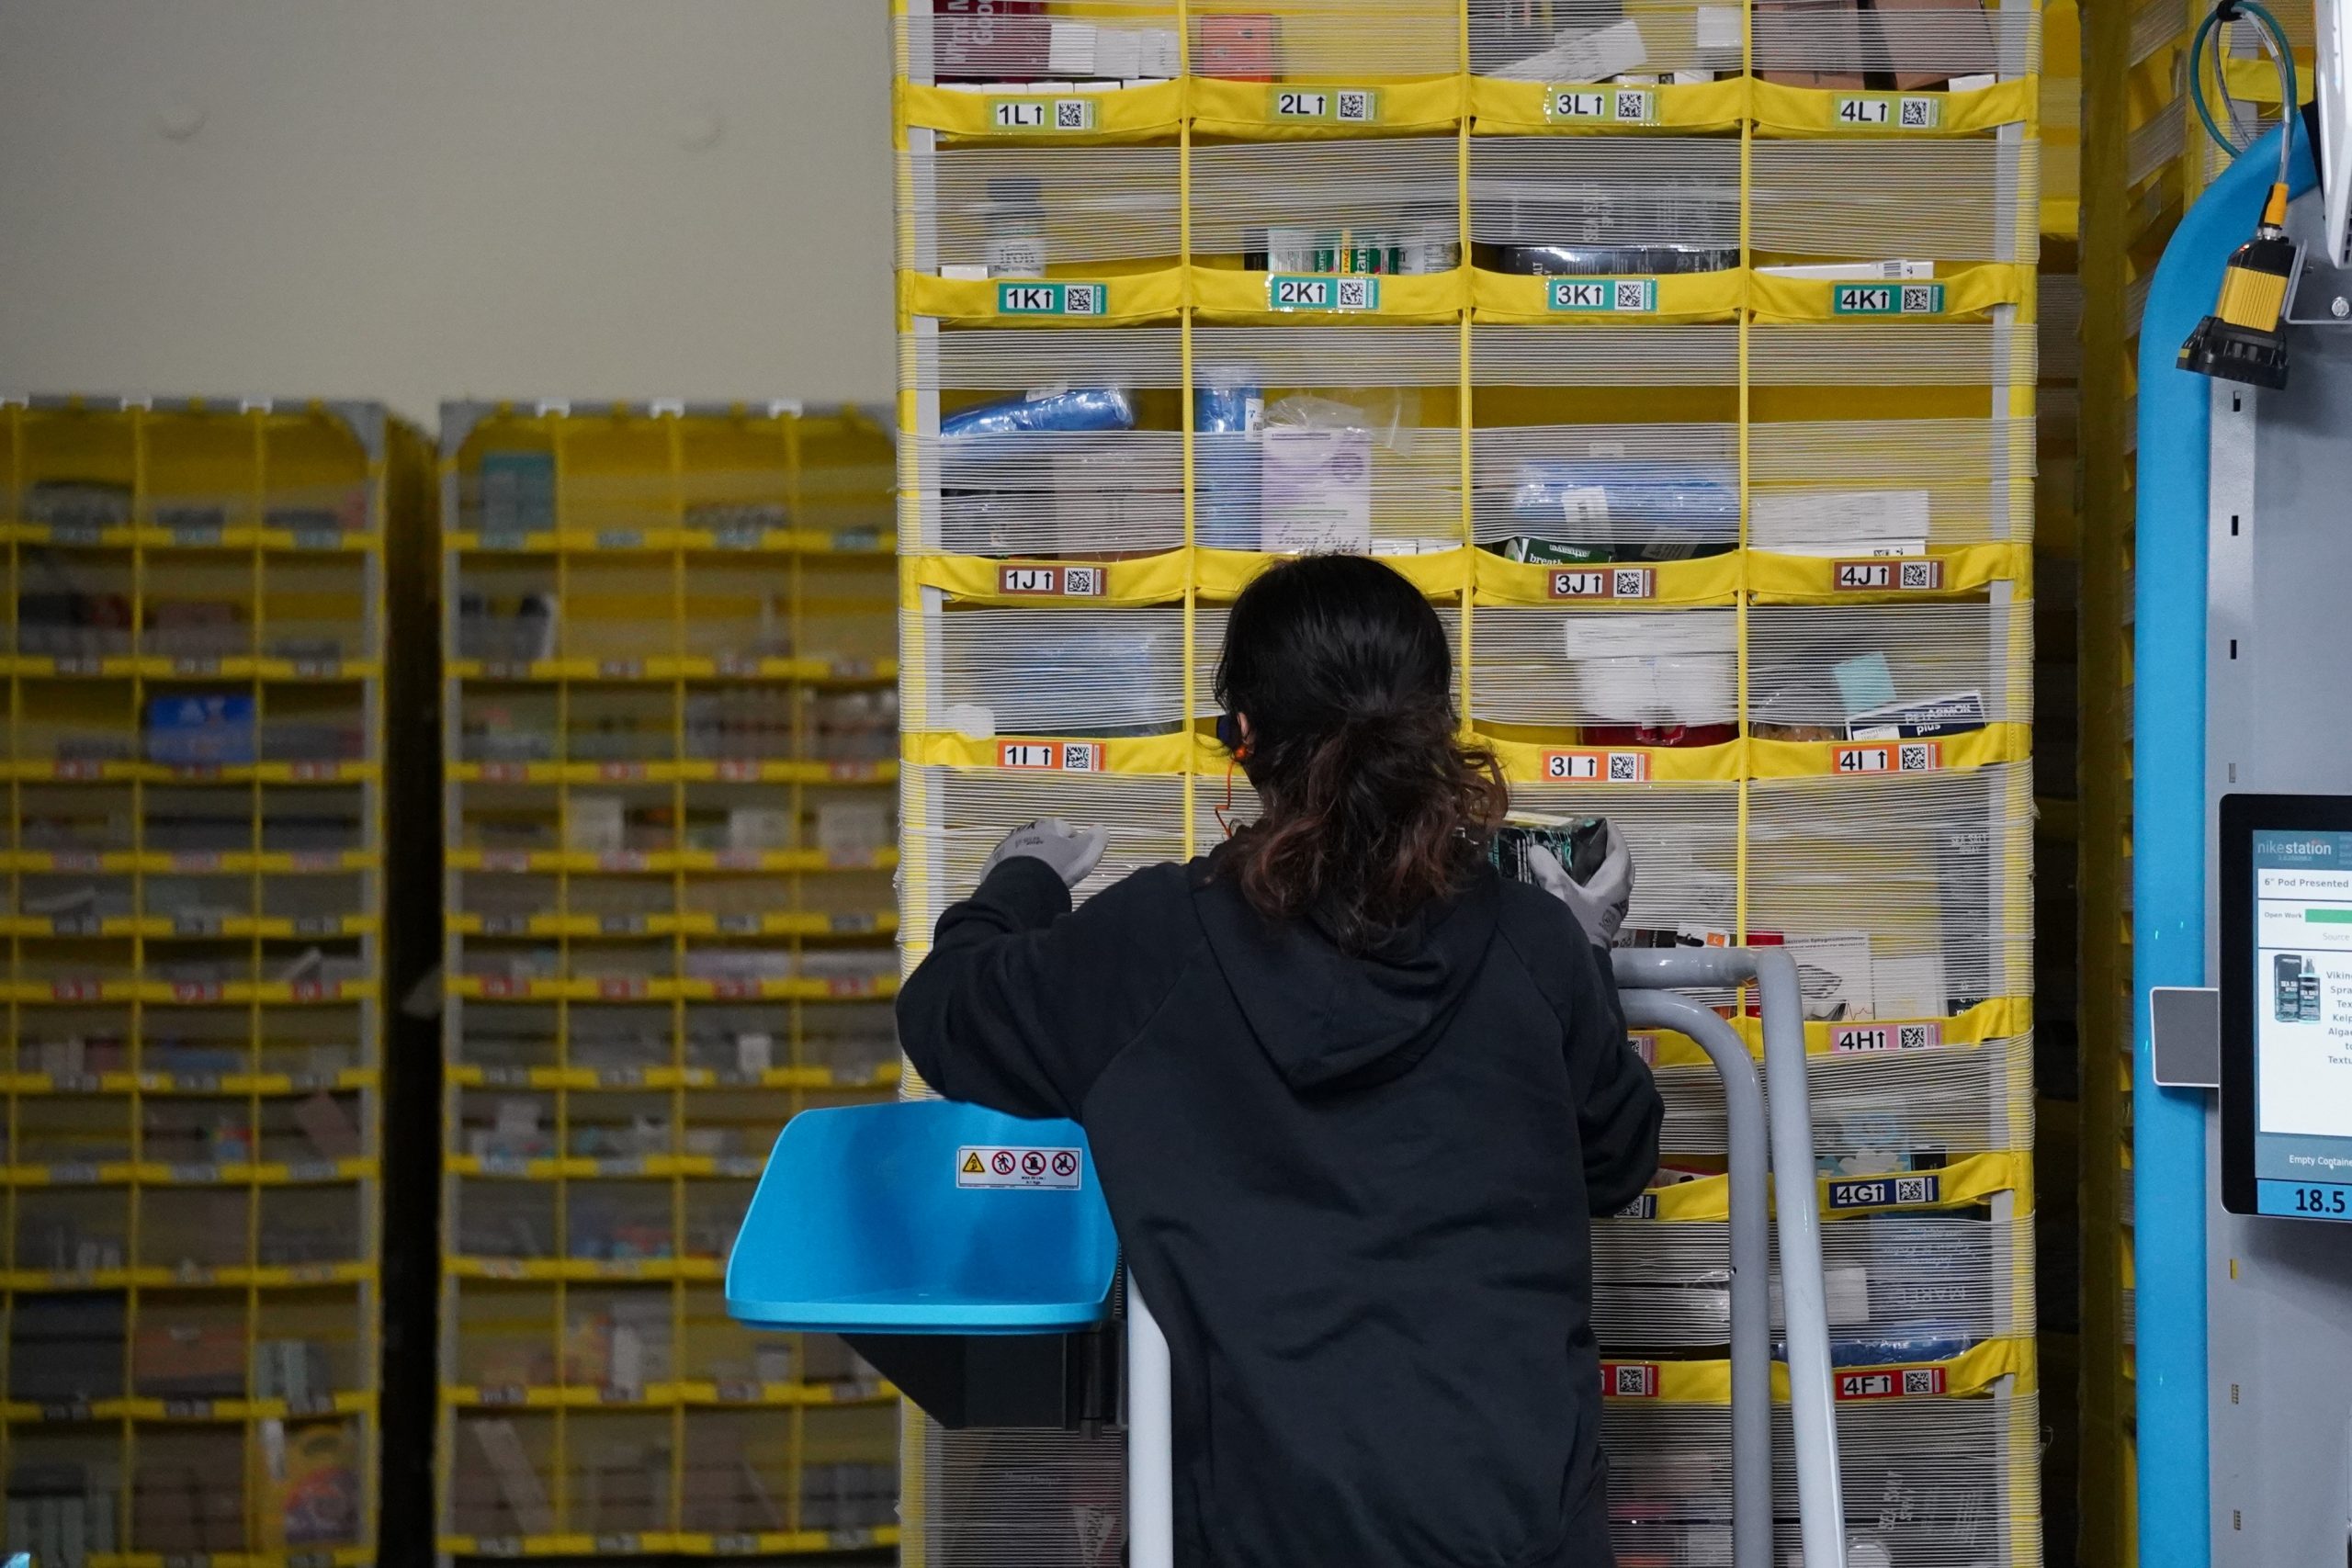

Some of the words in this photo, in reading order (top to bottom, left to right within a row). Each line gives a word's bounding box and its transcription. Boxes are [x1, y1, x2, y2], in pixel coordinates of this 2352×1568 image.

[999, 104, 1029, 125] 1L
[1280, 94, 1311, 115] 2L
[1558, 94, 1589, 115] 3L
[1840, 100, 1872, 122] 4L
[1008, 288, 1041, 309] 1K
[1281, 282, 1314, 303] 2K
[1558, 285, 1590, 305] 3K
[1842, 289, 1877, 310] 4K
[1008, 570, 1036, 590] 1J
[1557, 574, 1586, 594] 3J
[1840, 566, 1871, 586] 4J
[1007, 745, 1028, 765] 1I
[1840, 750, 1863, 772] 4I
[1551, 756, 1573, 777] 3I
[2257, 840, 2332, 855] nikestation
[2278, 878, 2296, 886] Pod
[2300, 878, 2349, 888] Presented
[2323, 932, 2350, 942] Source
[2336, 999, 2352, 1009] Tex
[1840, 1031, 1874, 1051] 4H
[2289, 1154, 2316, 1167] Empty
[1838, 1184, 1873, 1203] 4G
[2295, 1188, 2346, 1213] 18.5
[1845, 1375, 1875, 1395] 4F
